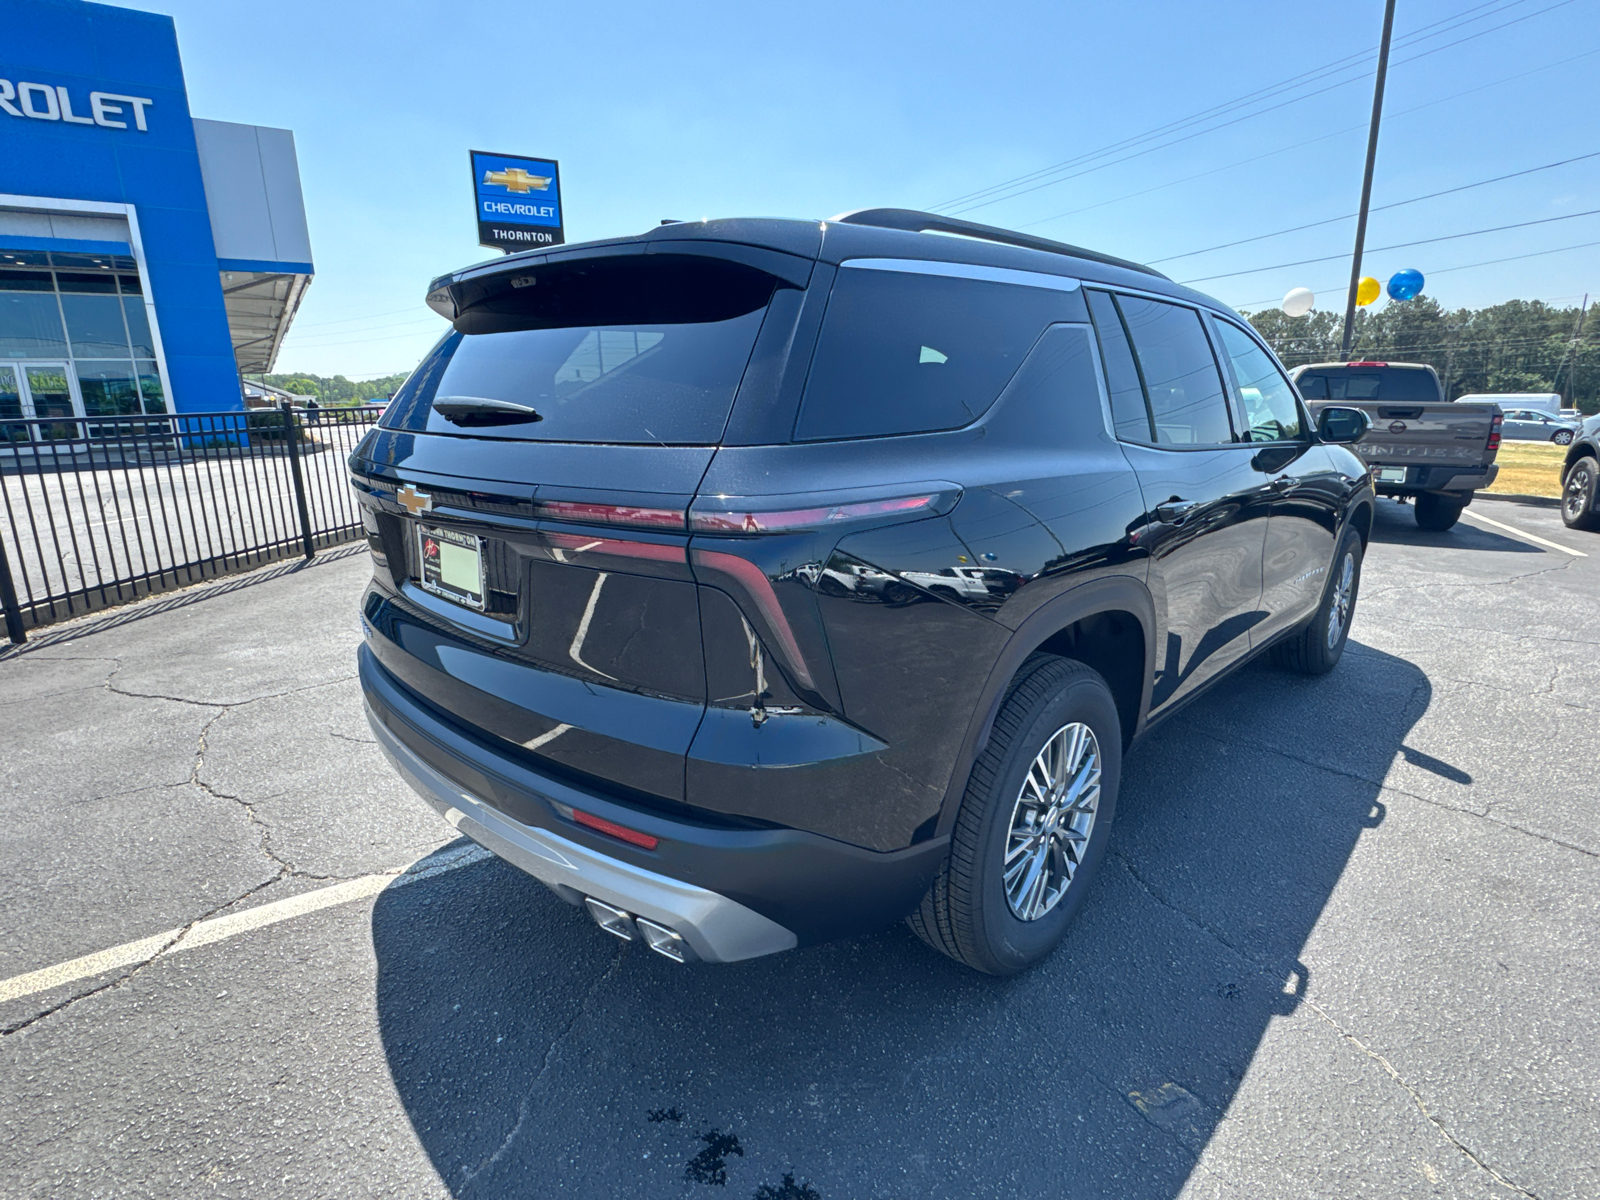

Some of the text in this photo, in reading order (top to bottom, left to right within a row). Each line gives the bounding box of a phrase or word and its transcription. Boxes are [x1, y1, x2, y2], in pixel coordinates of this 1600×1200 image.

[483, 201, 554, 217] CHEVROLET
[493, 229, 552, 242] THORNTON
[31, 376, 67, 390] SALES
